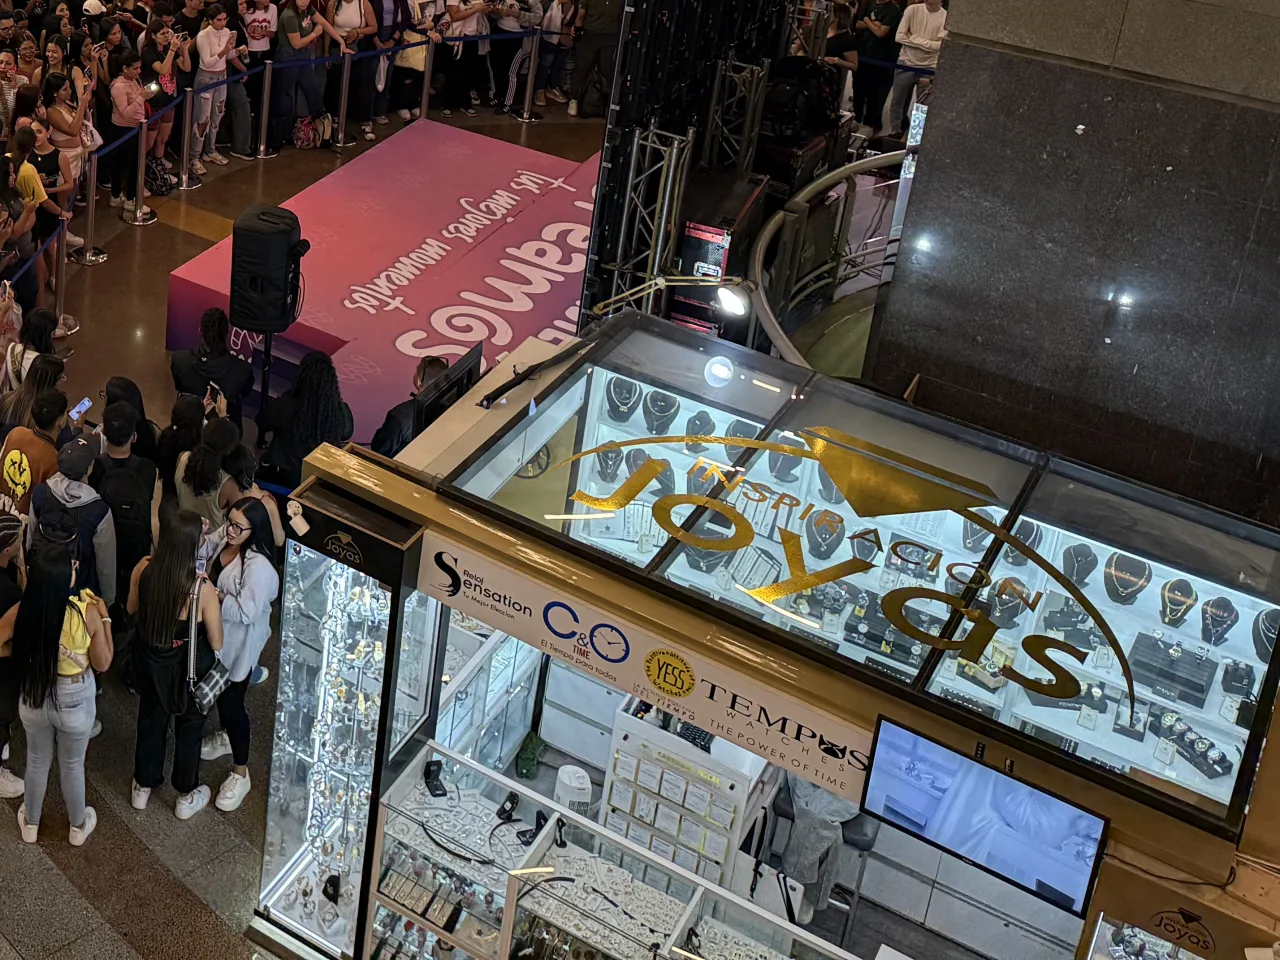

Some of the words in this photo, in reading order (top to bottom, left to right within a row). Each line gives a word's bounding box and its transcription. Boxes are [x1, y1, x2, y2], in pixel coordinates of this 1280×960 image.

[510, 170, 576, 194] tus
[442, 189, 521, 243] mejores
[344, 238, 451, 315] momentos
[326, 540, 360, 564] Joyas
[429, 551, 533, 617] Sensation
[463, 569, 484, 585] Reloj
[471, 595, 489, 608] Mejor
[541, 639, 547, 648] El
[549, 642, 574, 661] Tiempo
[575, 657, 594, 671] para
[595, 666, 617, 682] todos
[572, 644, 591, 660] TIME
[657, 658, 686, 690] YESS
[632, 687, 651, 699] DEL
[656, 698, 695, 721] TIEMPO
[710, 719, 733, 736] THE
[737, 732, 786, 761] POWER
[791, 759, 810, 772] OF
[814, 768, 847, 791] TIME
[726, 709, 845, 772] WATCHES
[1154, 916, 1210, 950] Joyas
